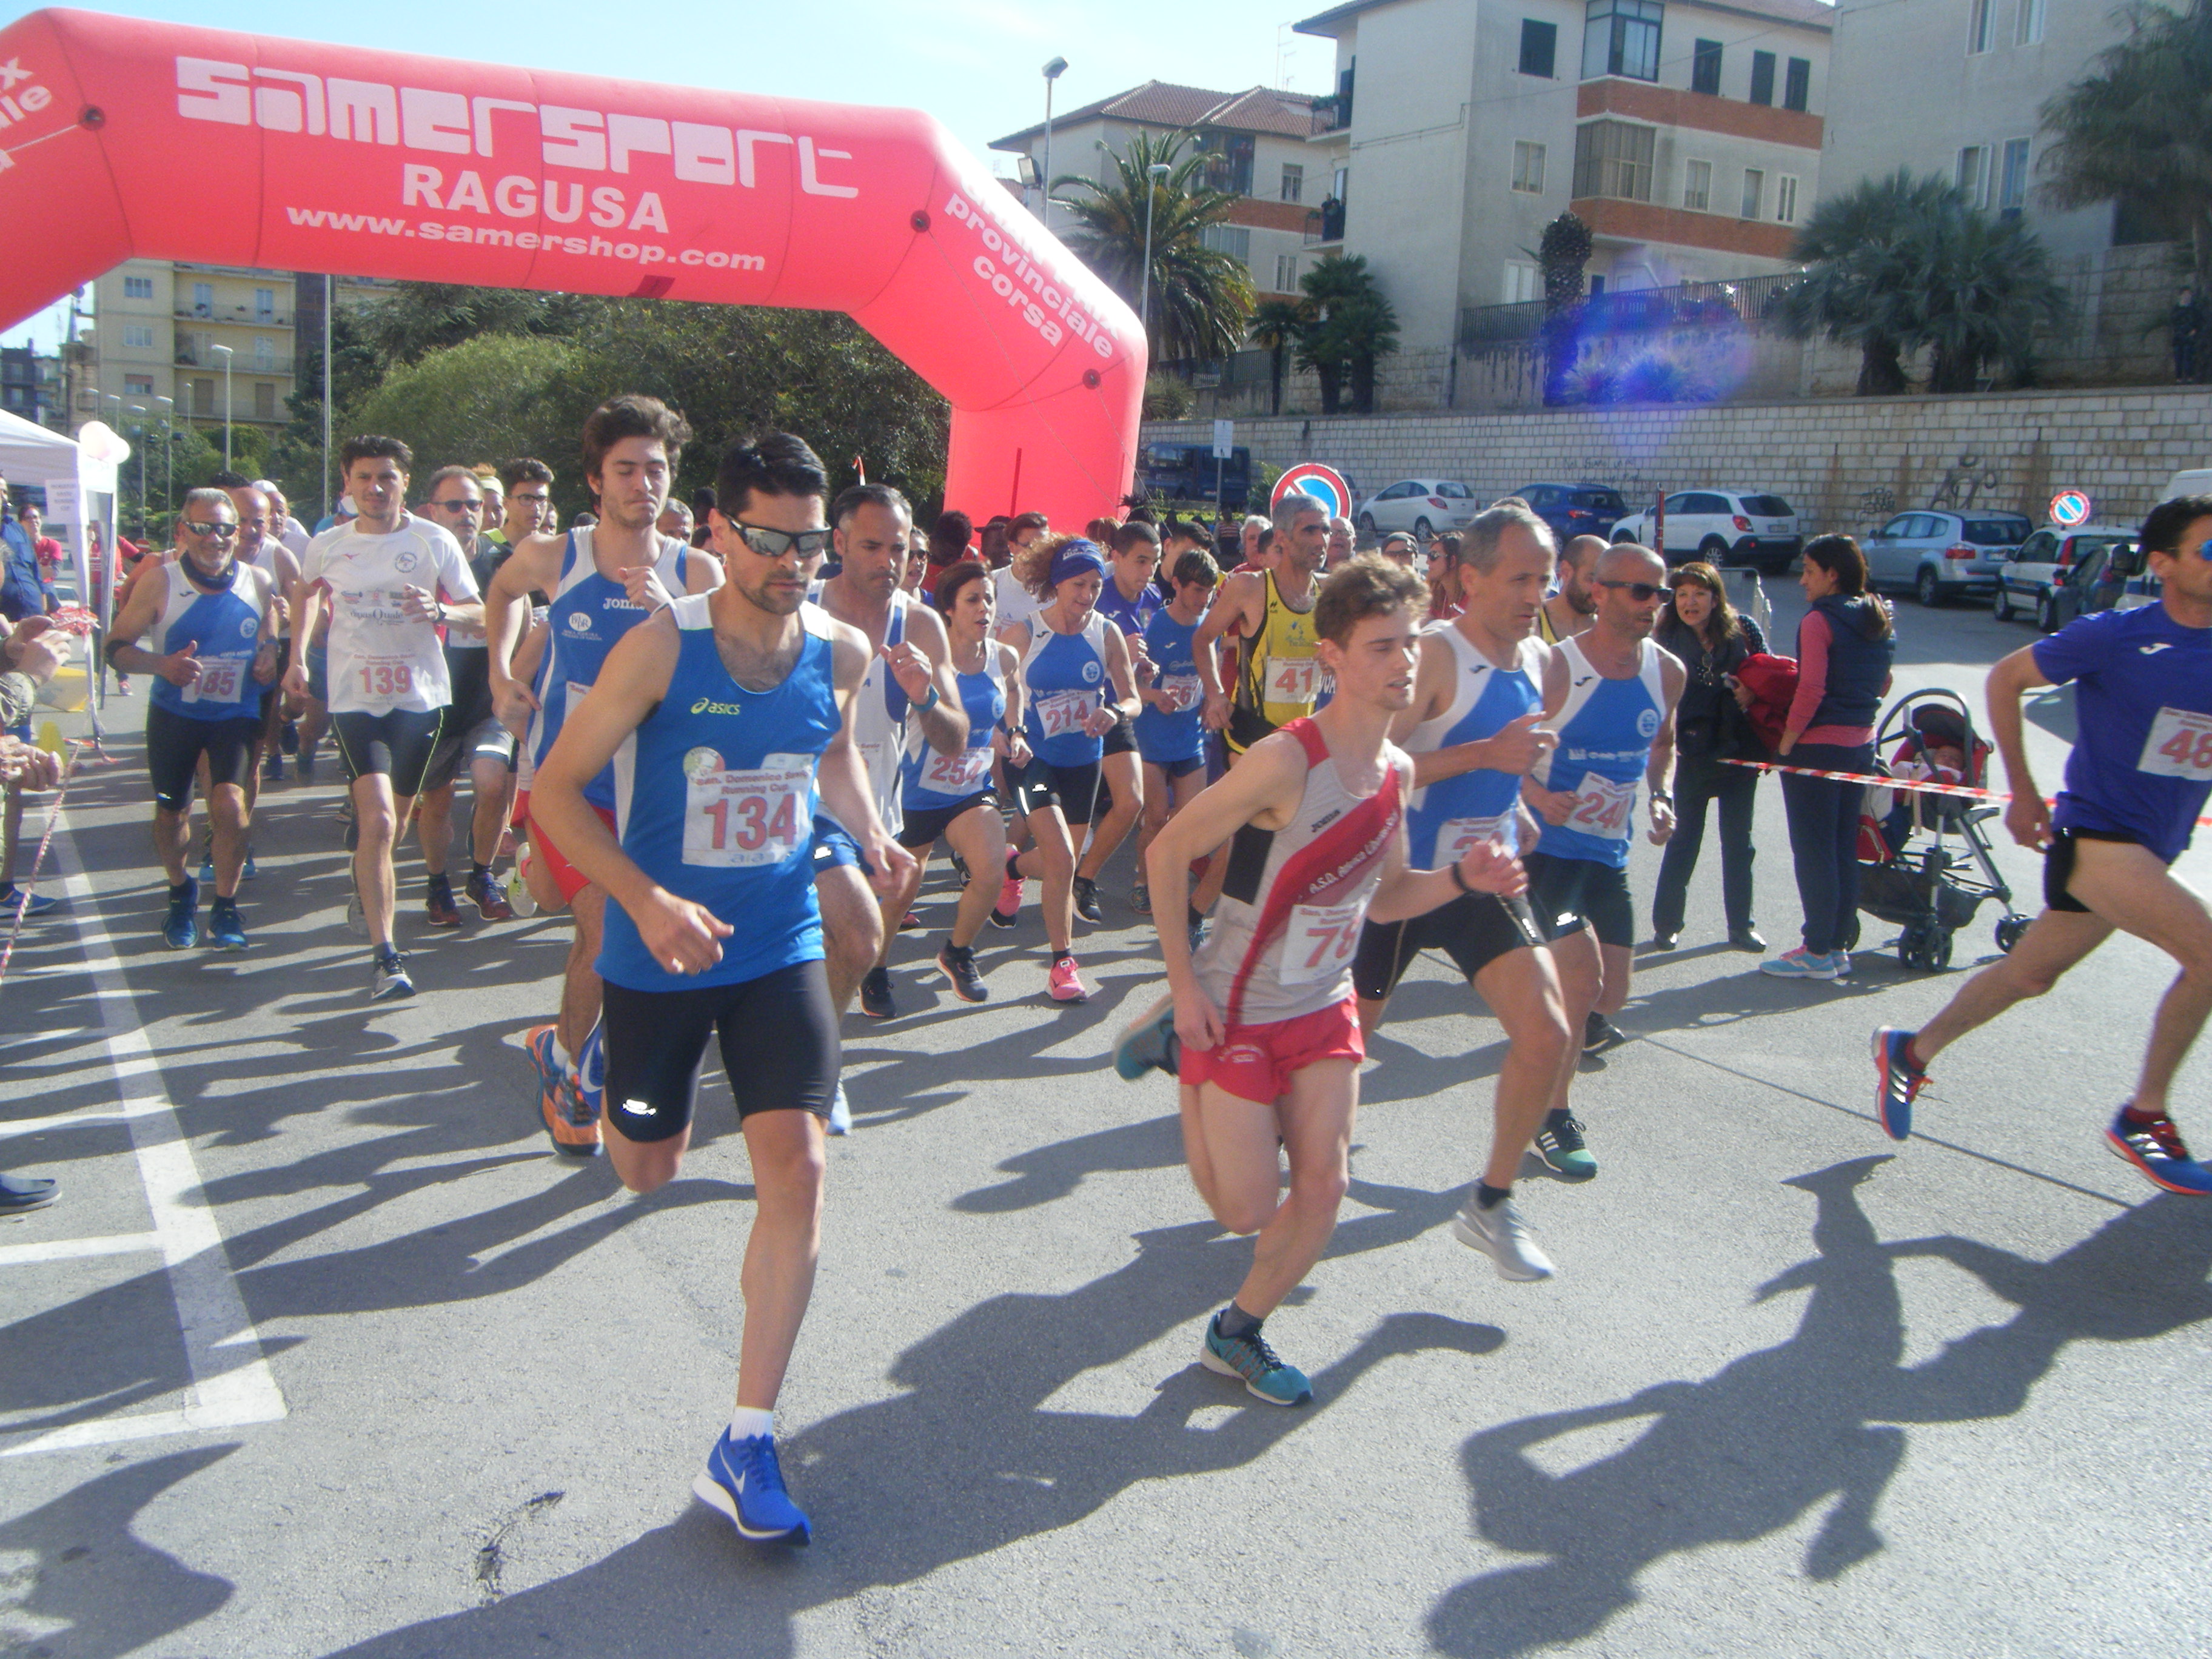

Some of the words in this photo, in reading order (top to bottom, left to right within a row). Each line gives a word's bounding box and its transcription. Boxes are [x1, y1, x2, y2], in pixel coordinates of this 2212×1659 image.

[403, 164, 669, 233] RAGUSA
[286, 207, 765, 271] www.samershop.com
[944, 193, 1113, 358] provinciale
[973, 255, 1063, 347] corsa
[359, 666, 412, 694] 139
[1275, 668, 1313, 693] 41
[1046, 699, 1089, 734] 214
[930, 757, 984, 785] 254
[703, 794, 797, 850] 134
